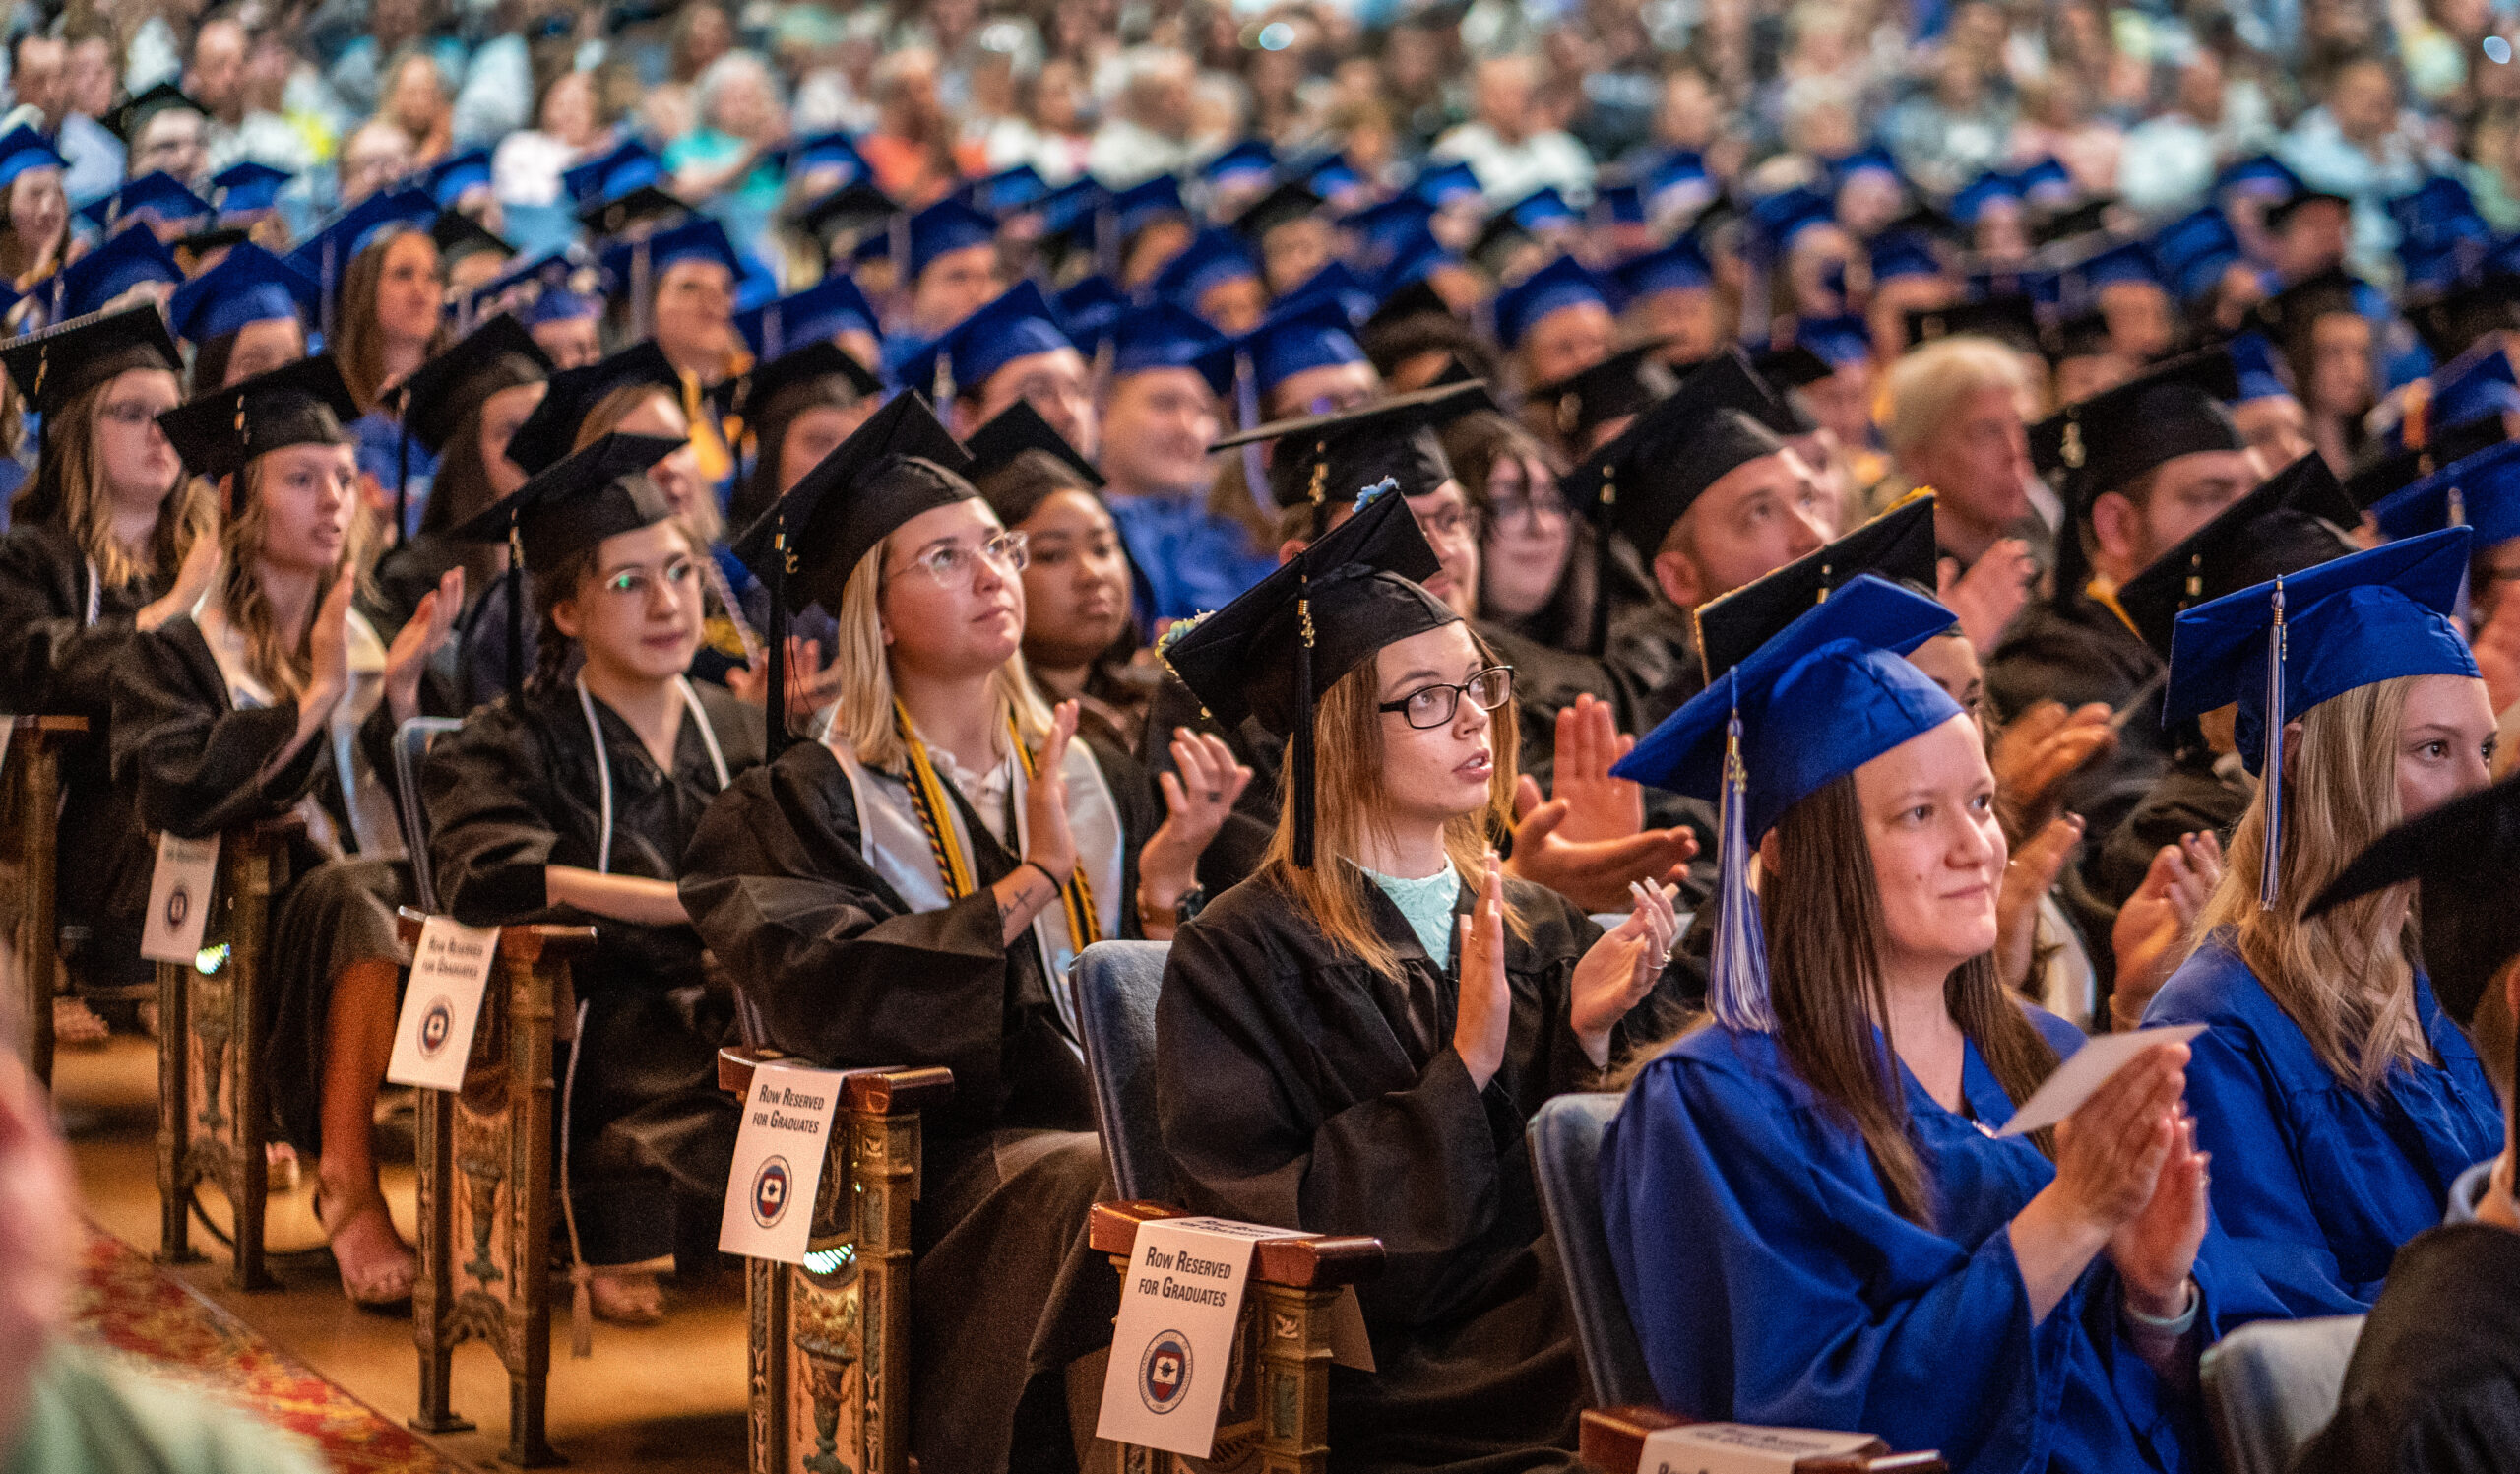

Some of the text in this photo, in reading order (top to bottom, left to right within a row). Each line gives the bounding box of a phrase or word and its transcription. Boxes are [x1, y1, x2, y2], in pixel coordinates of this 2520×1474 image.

[759, 1084, 825, 1111] ROW RESERVED
[752, 1110, 820, 1134] FOR GRADUATES
[1145, 1246, 1232, 1280] ROW RESERVED
[1138, 1276, 1228, 1308] FOR GRADUATES
